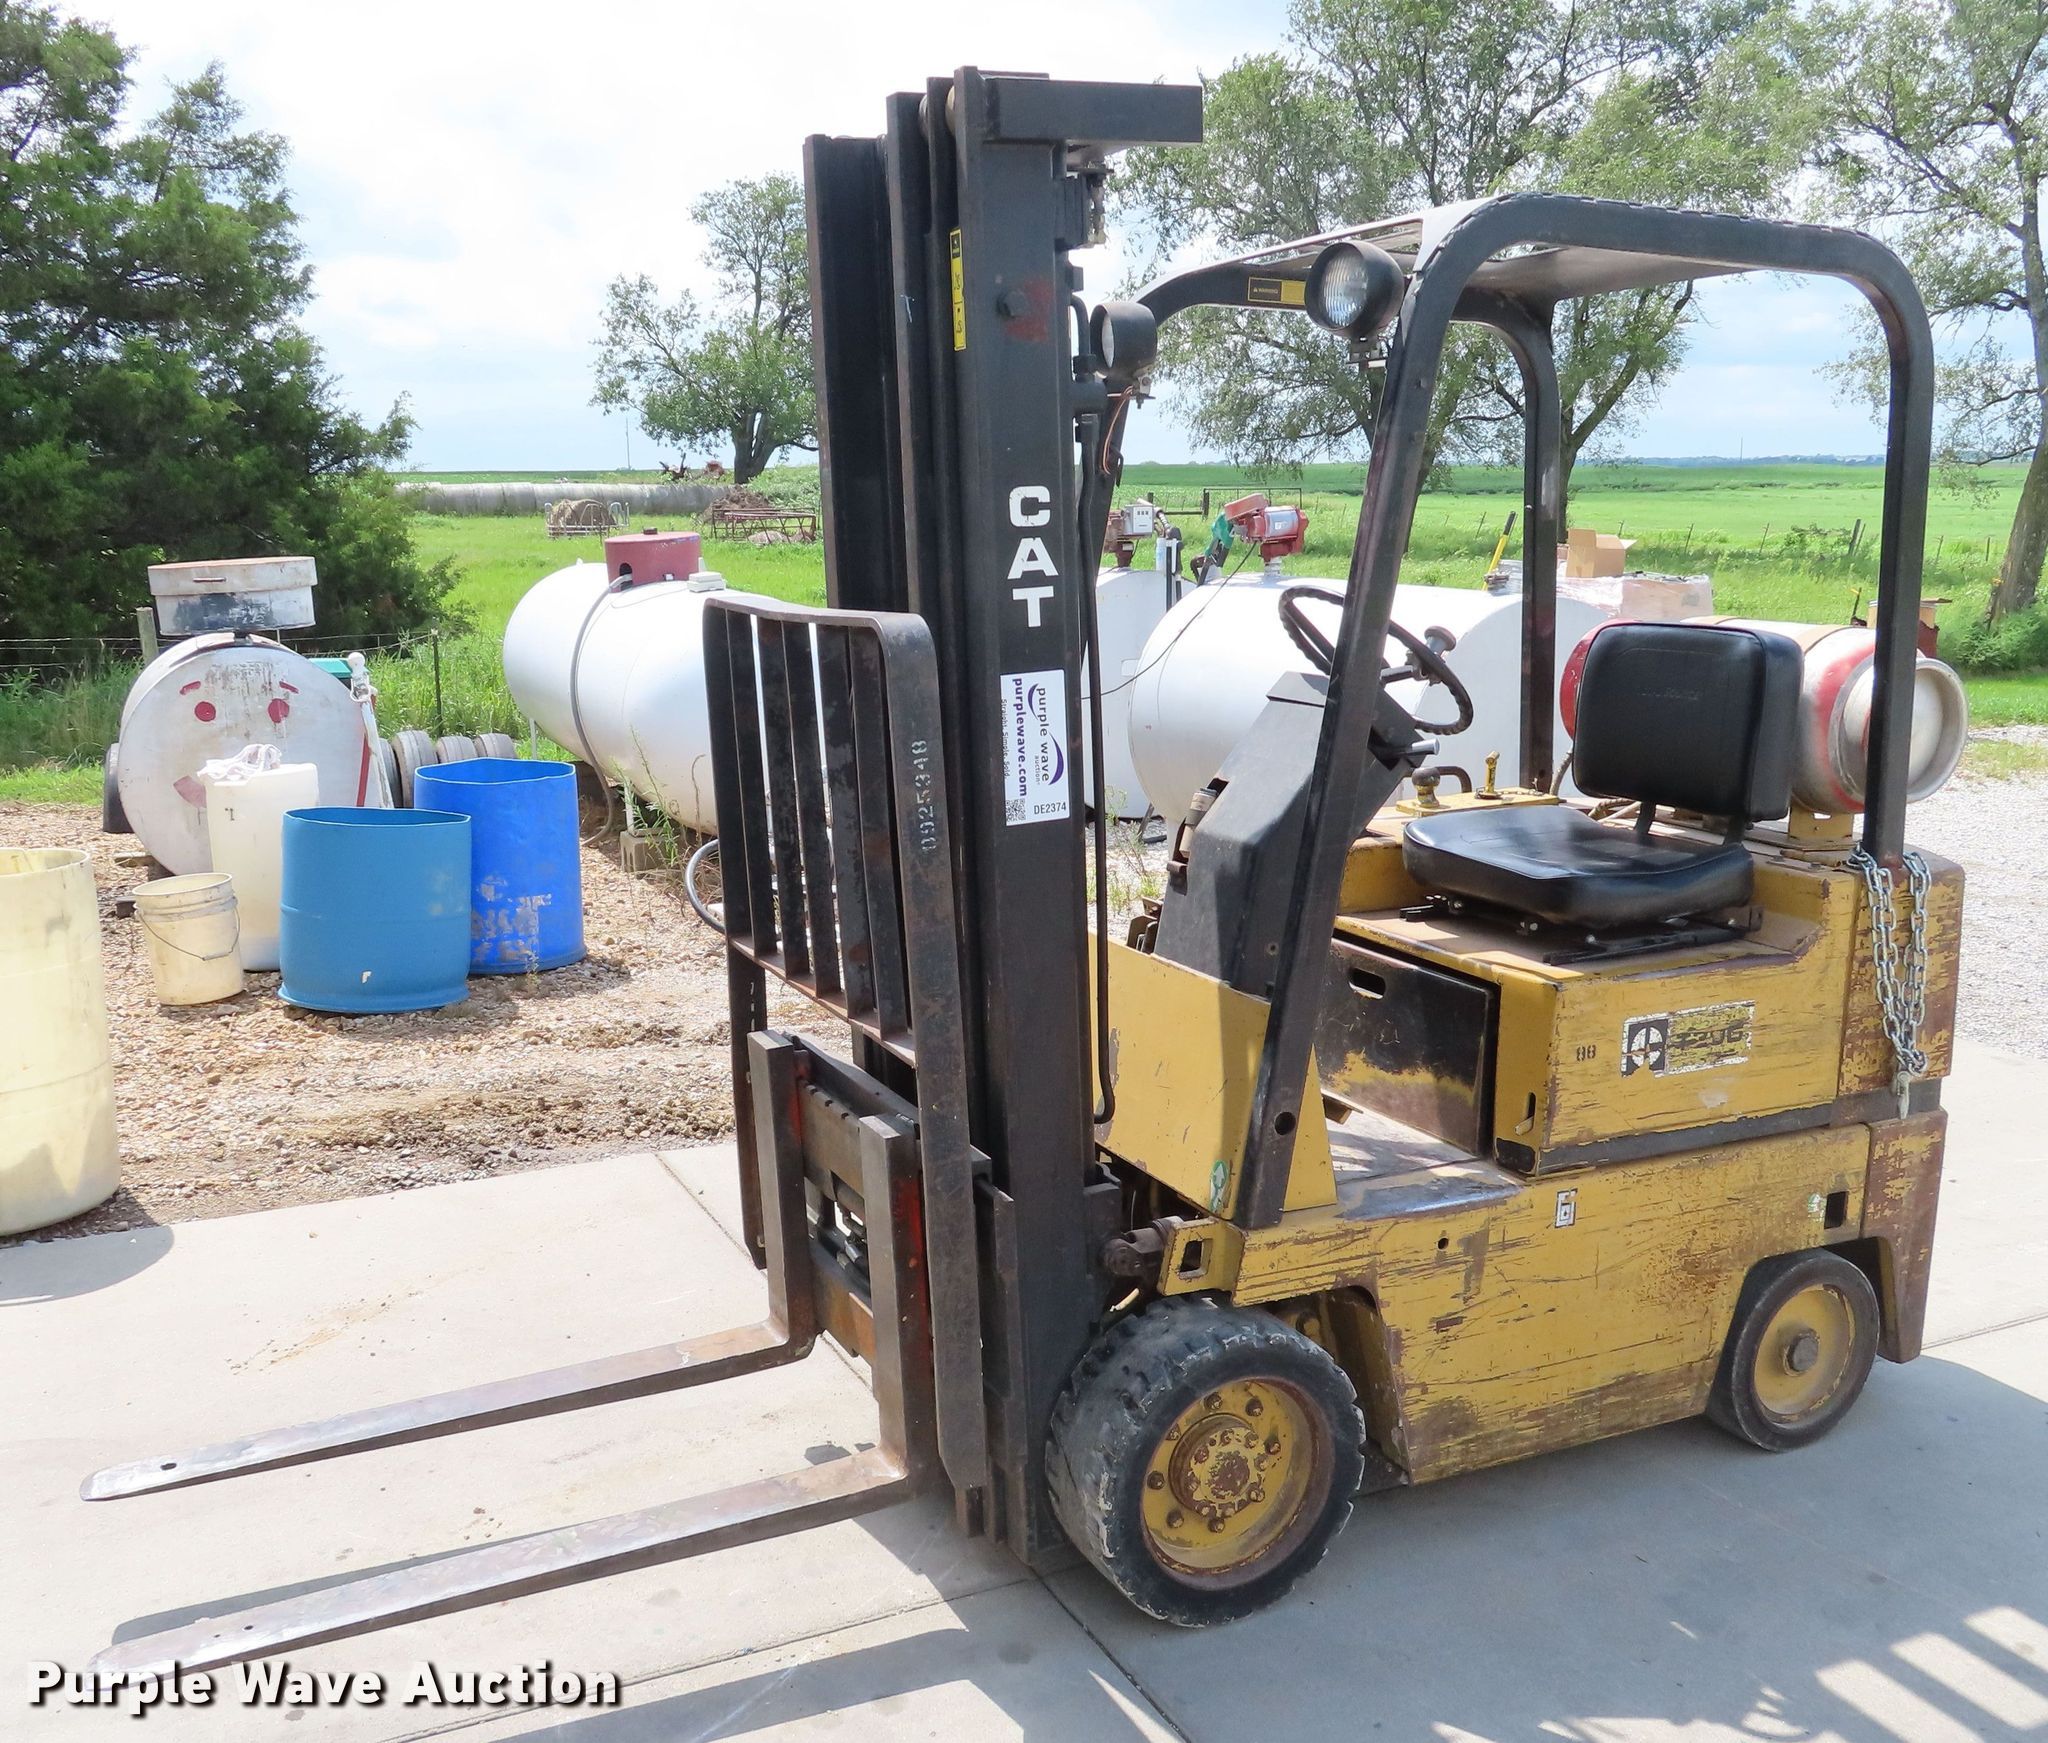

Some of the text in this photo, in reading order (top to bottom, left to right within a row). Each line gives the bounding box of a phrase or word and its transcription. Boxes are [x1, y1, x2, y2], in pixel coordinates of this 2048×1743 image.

[1007, 485, 1059, 628] CAT
[1012, 678, 1028, 797] purplewave.com
[1036, 688, 1050, 782] purple wave
[1033, 801, 1067, 815] DE2374
